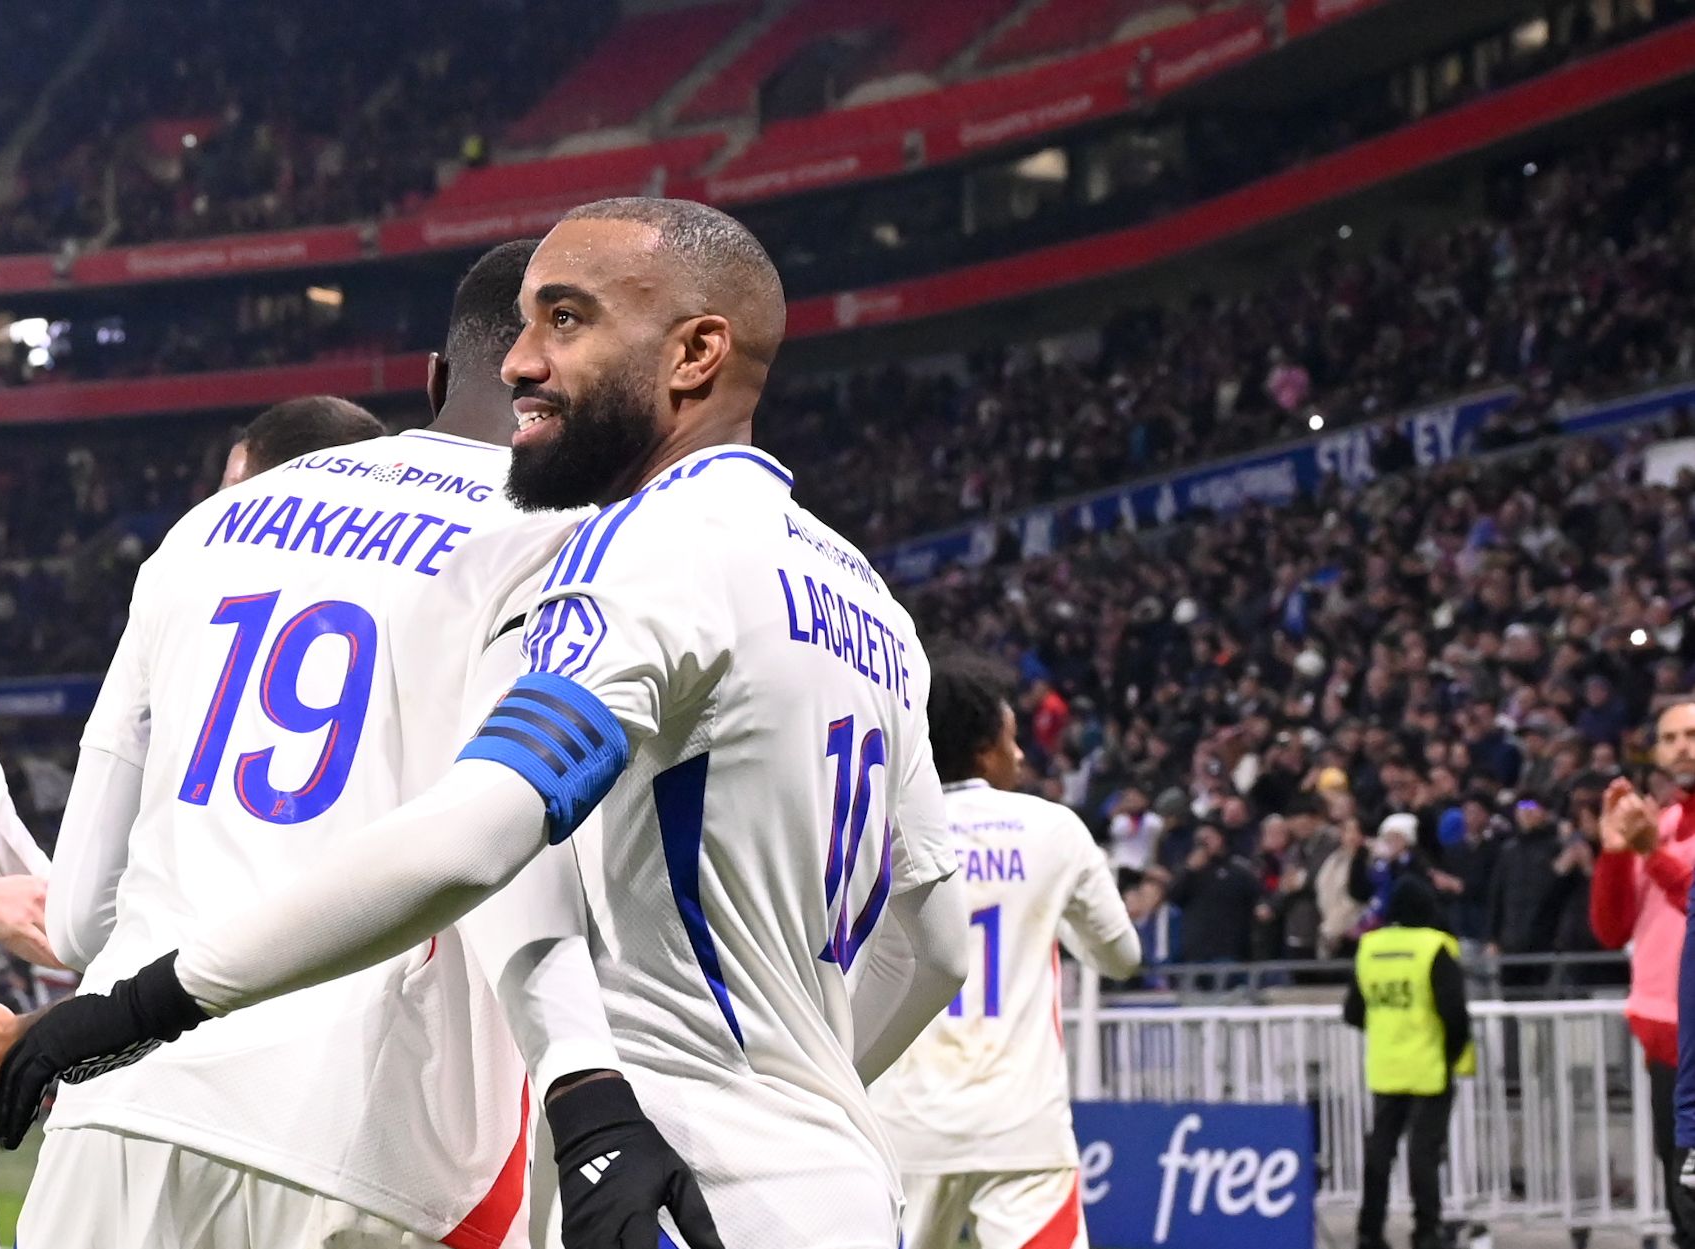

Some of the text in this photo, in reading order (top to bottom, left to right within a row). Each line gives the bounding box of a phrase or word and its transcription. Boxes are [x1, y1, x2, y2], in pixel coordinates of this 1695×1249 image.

[204, 495, 472, 576] NIAKHATE
[178, 589, 377, 825] 19
[777, 567, 911, 710] LACAZETTE
[817, 714, 892, 976] 10
[1154, 1113, 1300, 1244] free
